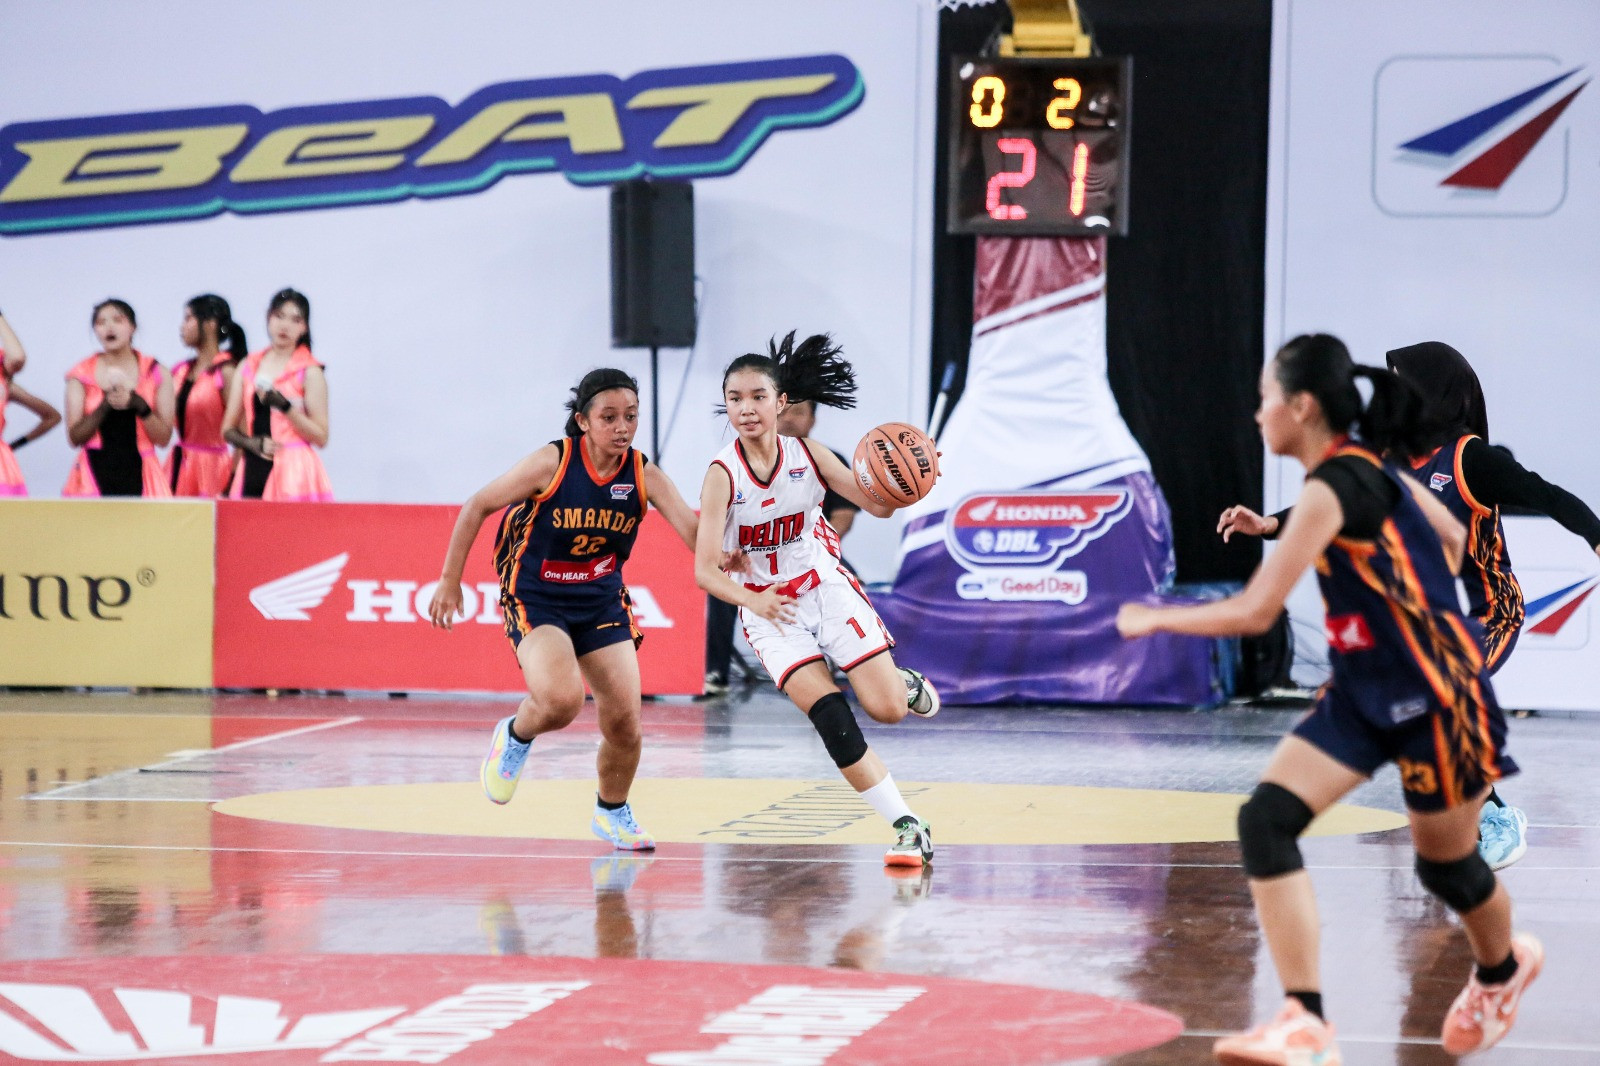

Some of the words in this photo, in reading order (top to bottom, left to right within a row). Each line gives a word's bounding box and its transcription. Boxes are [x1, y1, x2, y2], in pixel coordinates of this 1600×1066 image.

[874, 439, 915, 496] proteam
[909, 445, 931, 479] DBL
[552, 507, 637, 535] SMANDA
[994, 504, 1087, 521] HONDA
[739, 511, 804, 548] PELITA
[994, 529, 1041, 553] DBL
[544, 570, 561, 579] One
[765, 551, 779, 576] 1
[846, 617, 866, 639] 1
[317, 979, 592, 1064] HONDA
